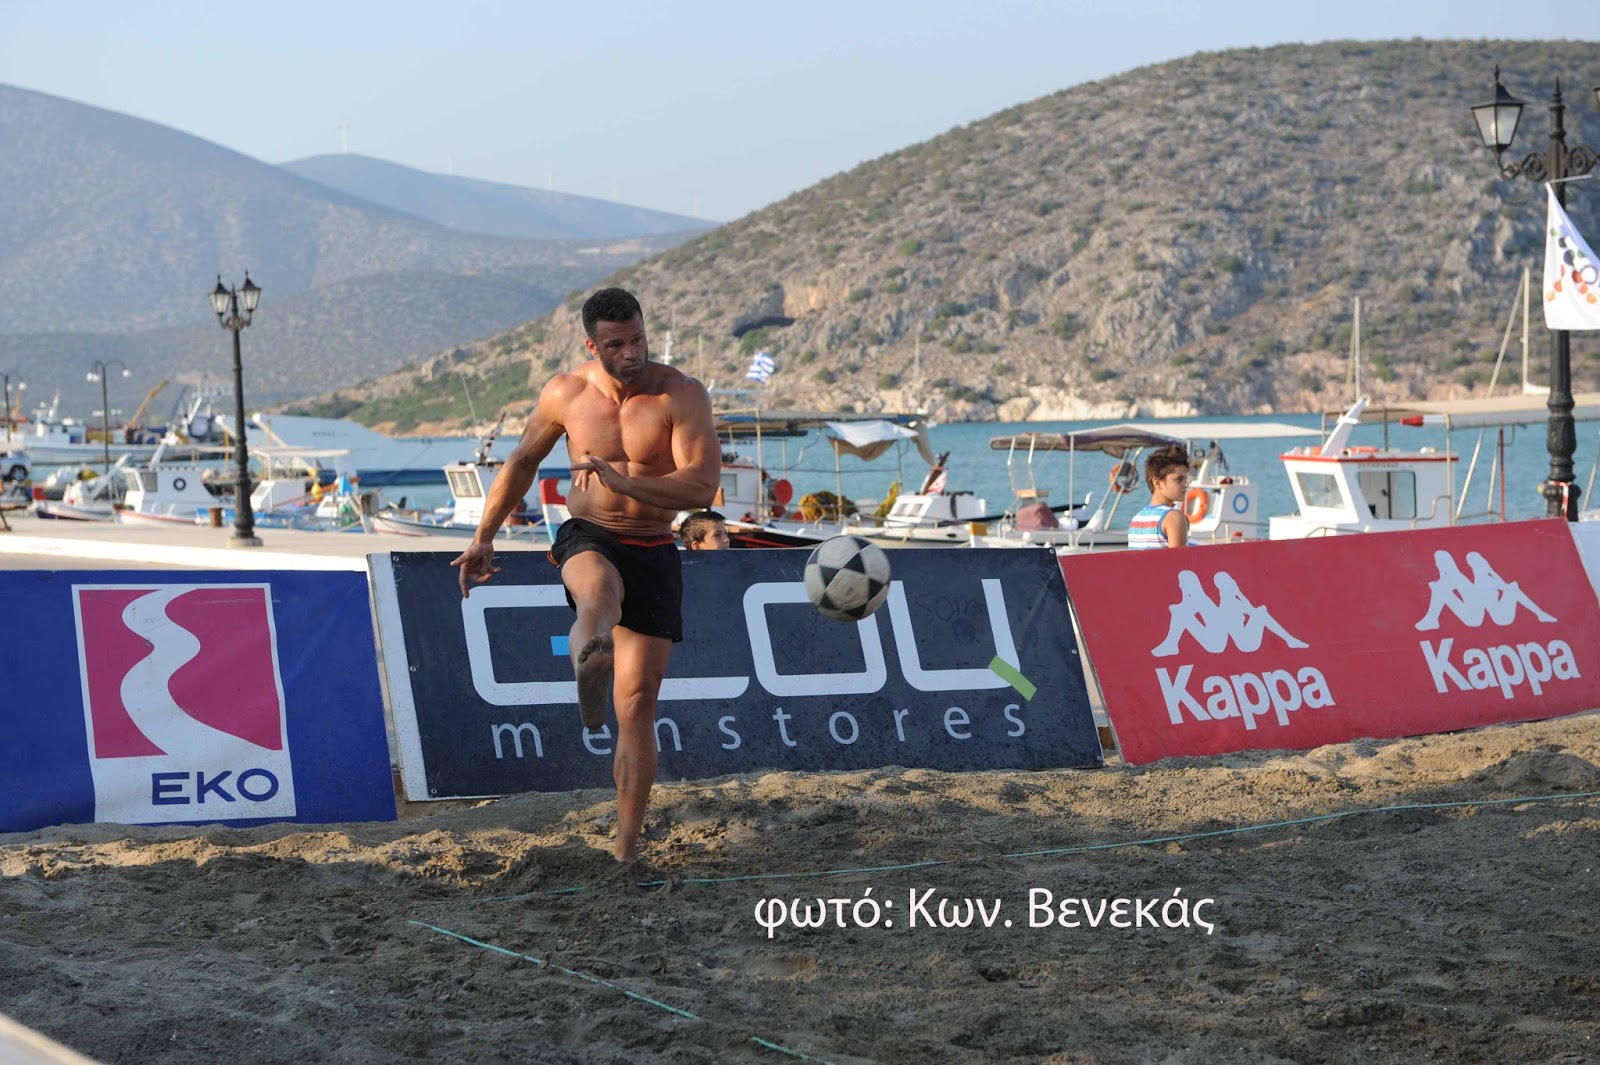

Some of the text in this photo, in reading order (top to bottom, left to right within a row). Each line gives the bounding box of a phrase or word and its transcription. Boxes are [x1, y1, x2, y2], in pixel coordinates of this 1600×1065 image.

[1155, 664, 1336, 731] Kappa
[1419, 637, 1581, 700] Kappa
[151, 768, 279, 806] EKO
